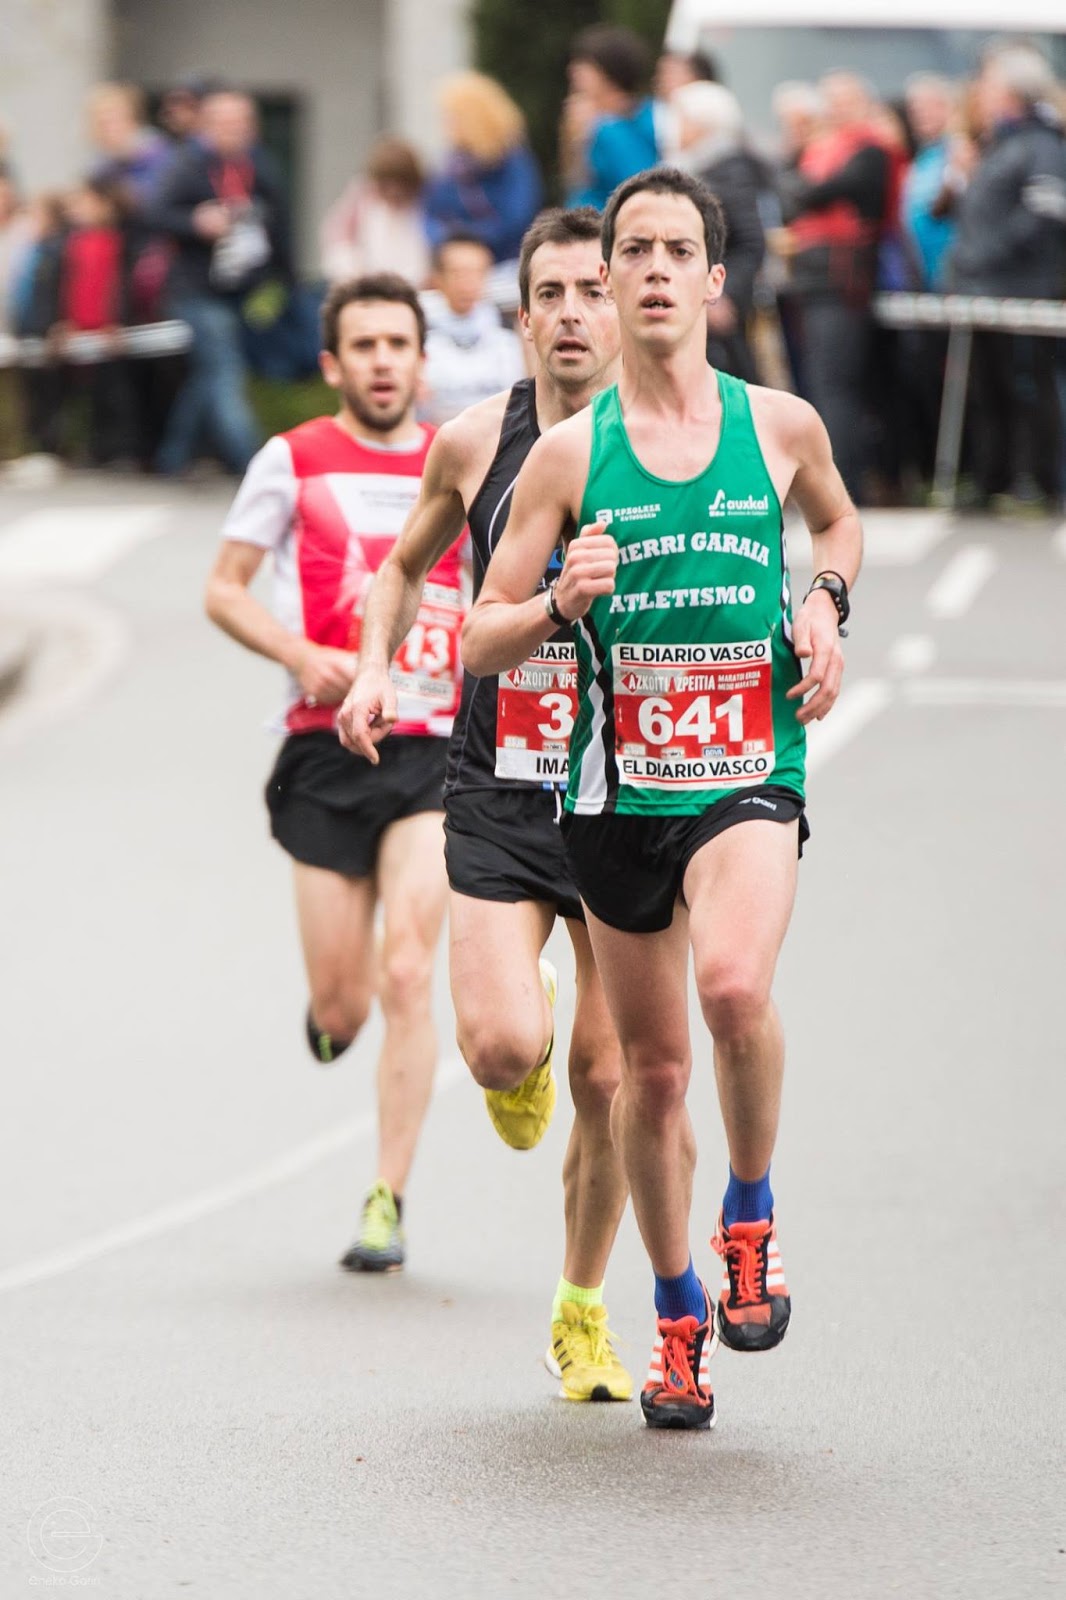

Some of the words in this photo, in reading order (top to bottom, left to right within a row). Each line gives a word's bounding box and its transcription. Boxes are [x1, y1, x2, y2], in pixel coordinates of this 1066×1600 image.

[619, 534, 685, 565] IERRI
[690, 532, 770, 567] GARAIA
[609, 584, 756, 614] ATLETISMO
[404, 623, 449, 670] 13
[531, 645, 575, 660] IARI
[619, 646, 640, 661] EL
[643, 647, 706, 662] DIARIO
[709, 643, 766, 660] VASCO
[537, 692, 575, 739] 3
[638, 693, 744, 745] 641
[536, 756, 570, 775] IMA
[623, 760, 643, 775] EL
[646, 761, 706, 778] DIARIO
[709, 758, 767, 776] VASCO
